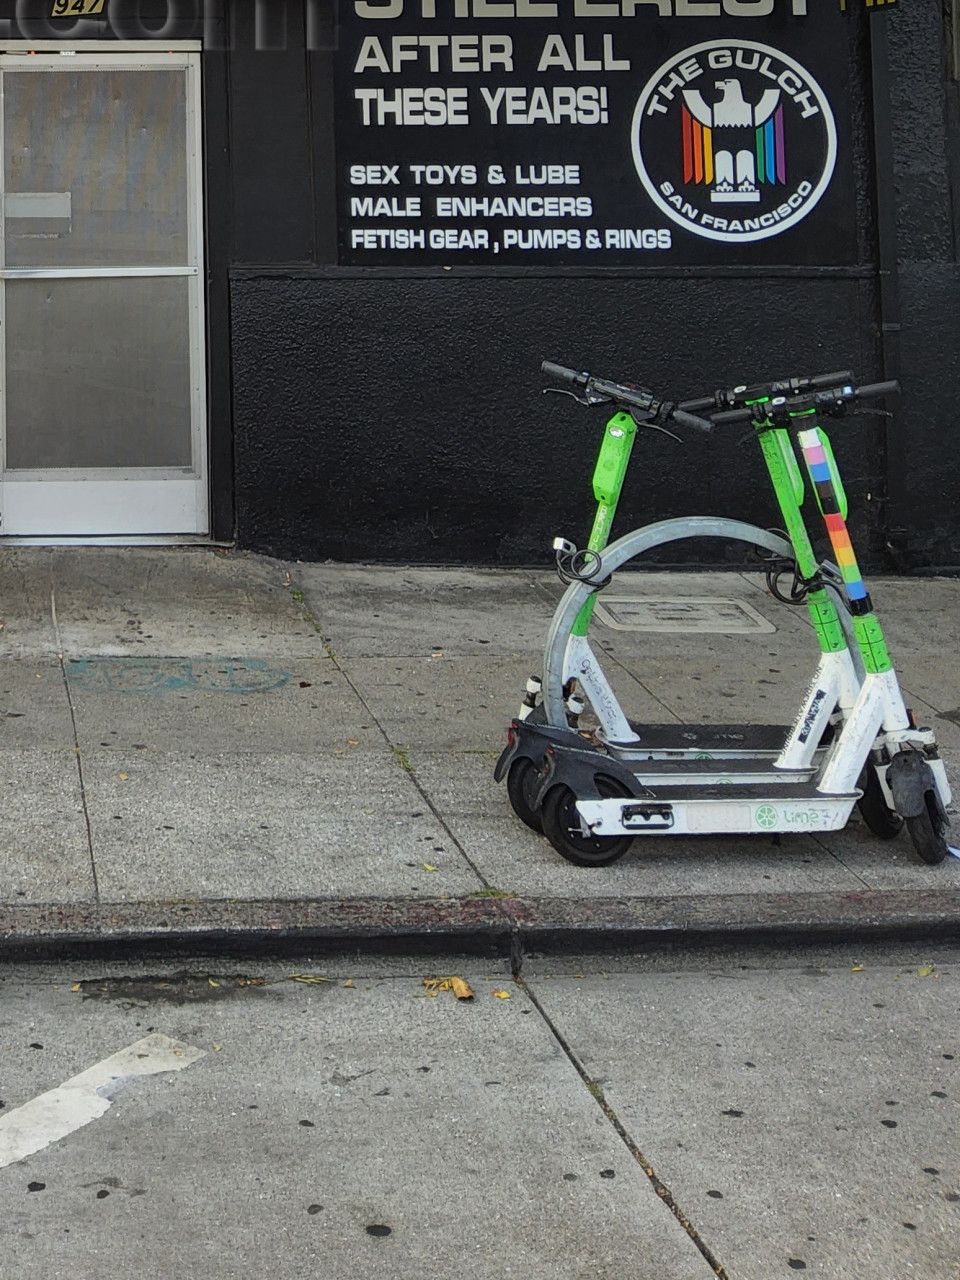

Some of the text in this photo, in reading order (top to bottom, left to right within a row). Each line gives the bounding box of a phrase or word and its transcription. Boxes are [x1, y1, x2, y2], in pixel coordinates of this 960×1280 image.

[355, 33, 631, 73] AFTER ALL
[646, 49, 820, 119] THE GULCH
[355, 87, 609, 125] THESE YEARS!
[350, 165, 580, 184] SEX TOYS & LUBE
[351, 197, 593, 217] MALE ENHANCERS
[660, 180, 812, 232] SAN FRANCISCO
[351, 230, 425, 249] FETISH
[504, 230, 581, 249] PUMPS
[585, 230, 602, 249] &
[606, 229, 672, 249] RINGS
